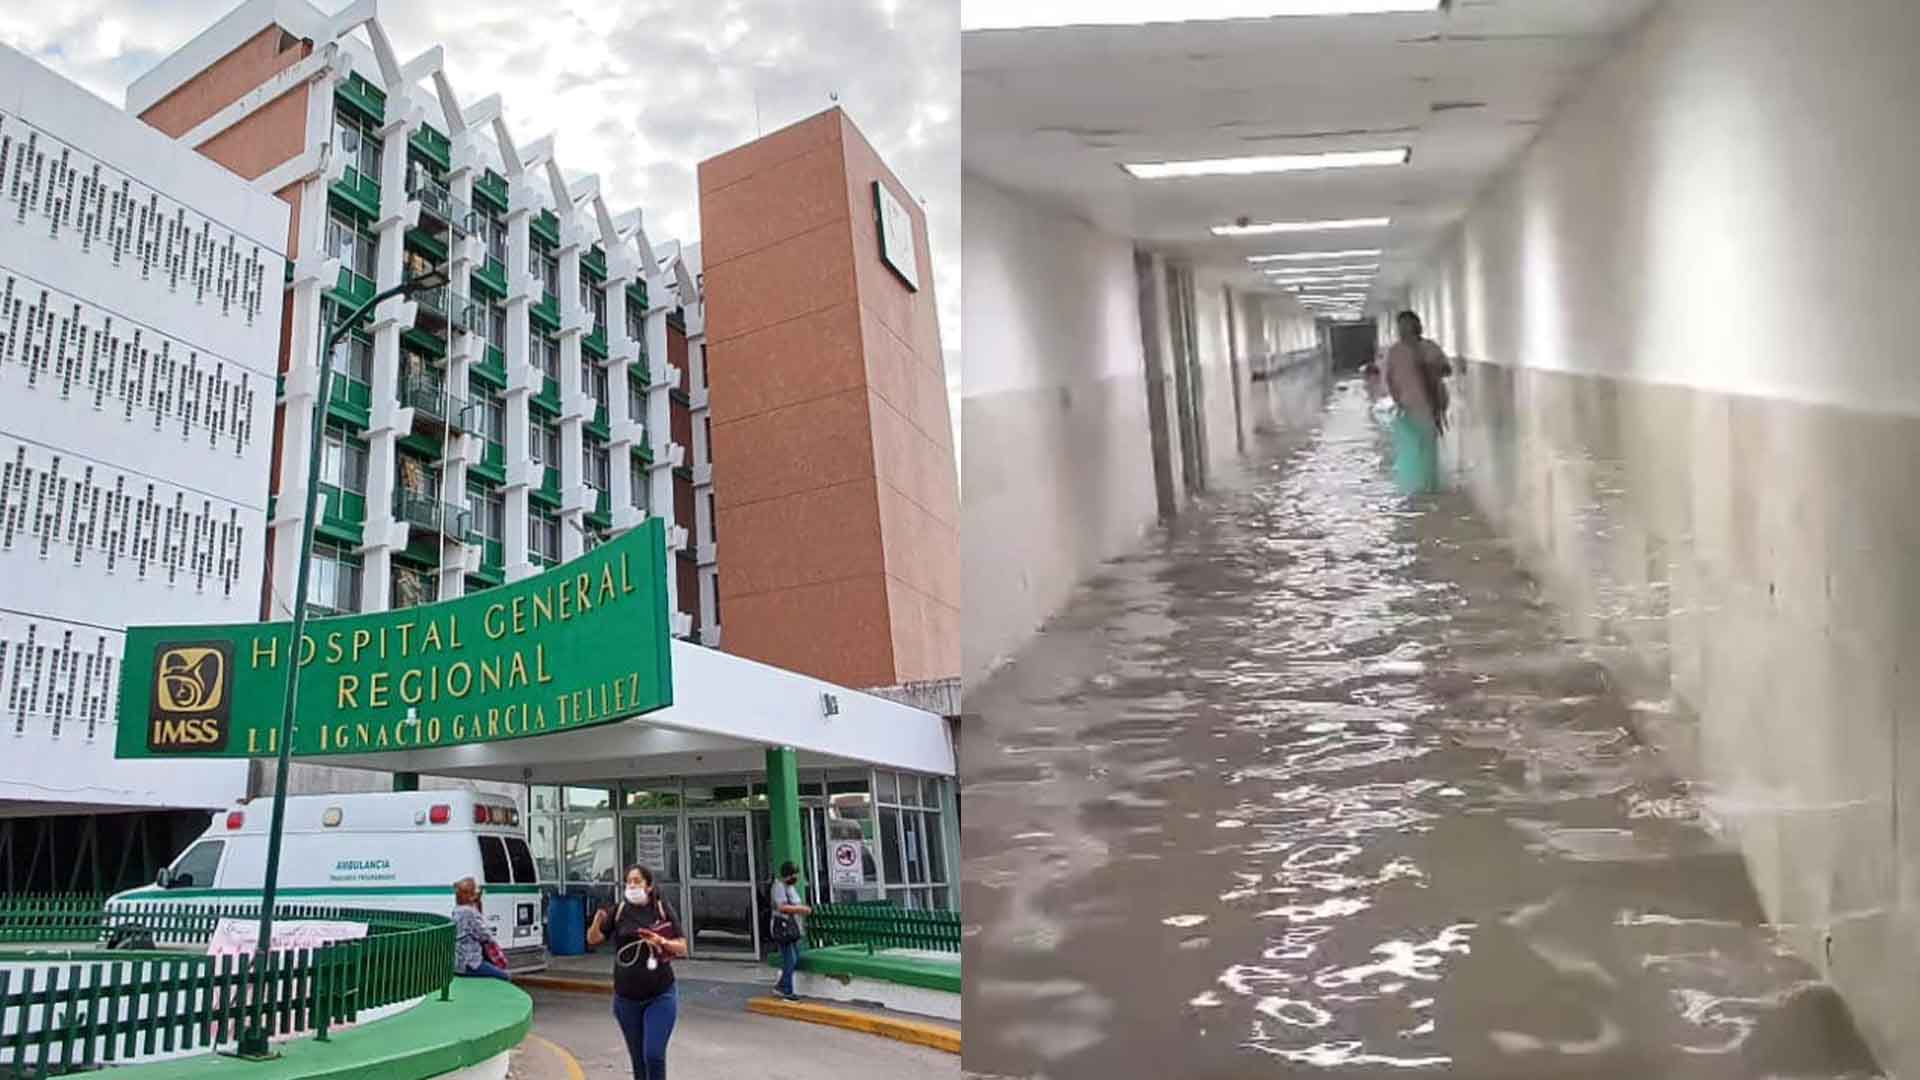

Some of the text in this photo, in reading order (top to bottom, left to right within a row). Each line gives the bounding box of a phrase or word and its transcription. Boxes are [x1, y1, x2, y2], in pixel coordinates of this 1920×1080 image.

[252, 551, 635, 669] HOSPITAL GENERAL
[337, 643, 552, 709] REGIONAL
[153, 718, 219, 744] IMSS
[320, 717, 441, 750] IGNACIO
[452, 703, 545, 741] GARCIA
[557, 672, 641, 725] TELLEZ
[336, 859, 390, 870] AMBULANCIA
